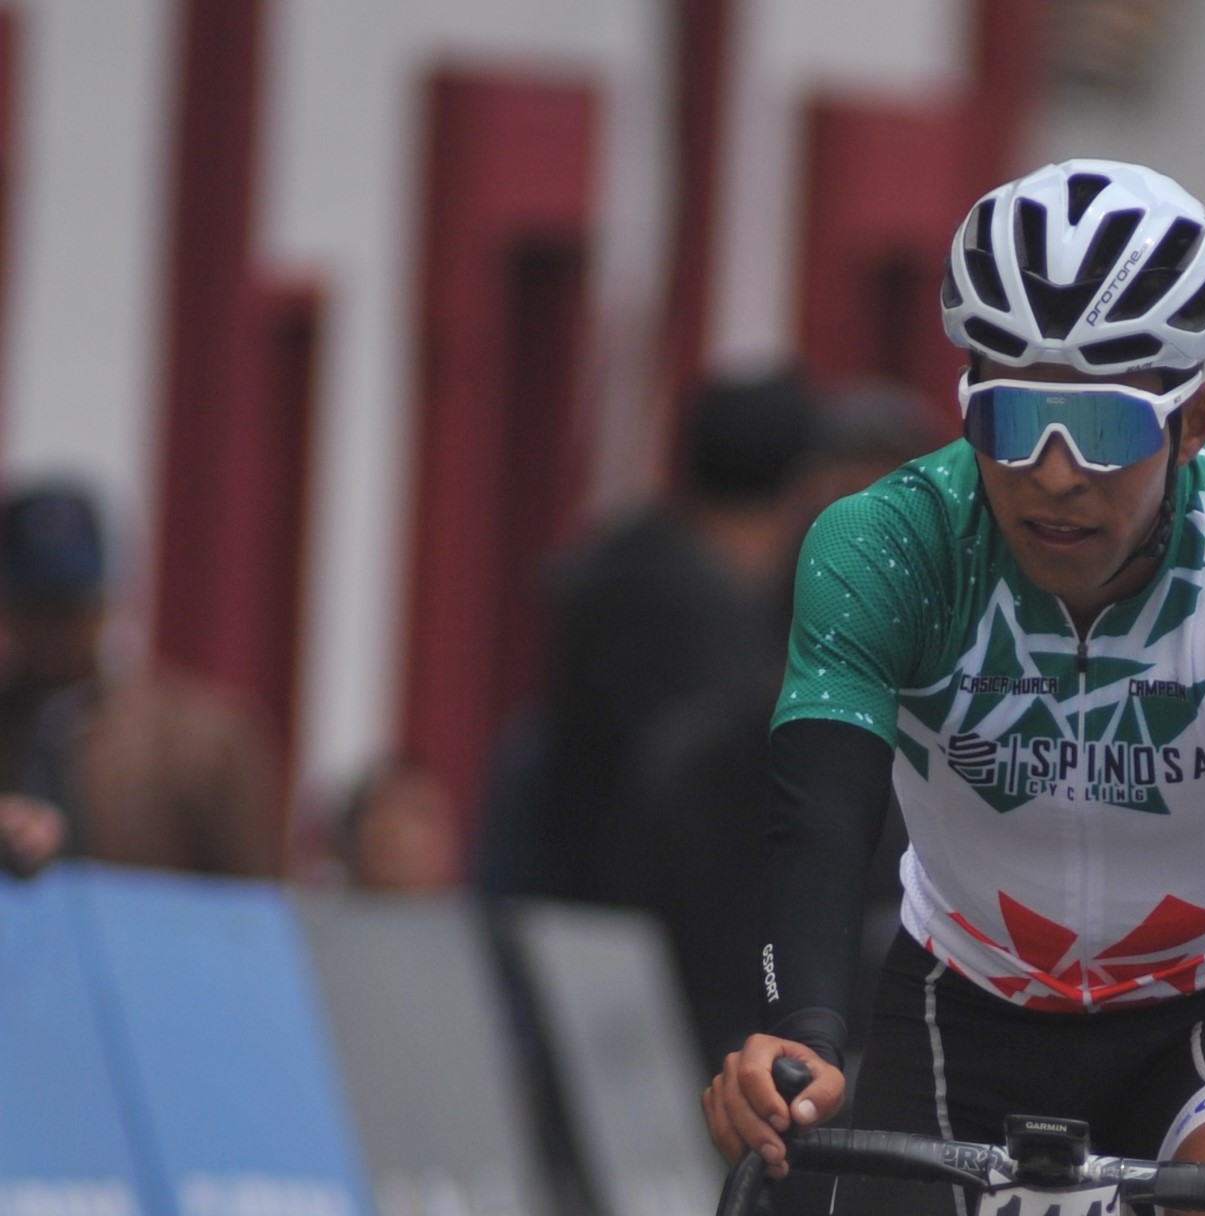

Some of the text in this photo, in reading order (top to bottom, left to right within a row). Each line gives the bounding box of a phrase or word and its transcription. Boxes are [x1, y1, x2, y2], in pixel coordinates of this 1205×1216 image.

[1029, 779, 1147, 801] CYCLING
[763, 943, 779, 1002] GSPORT
[1025, 1121, 1067, 1133] GARMIN
